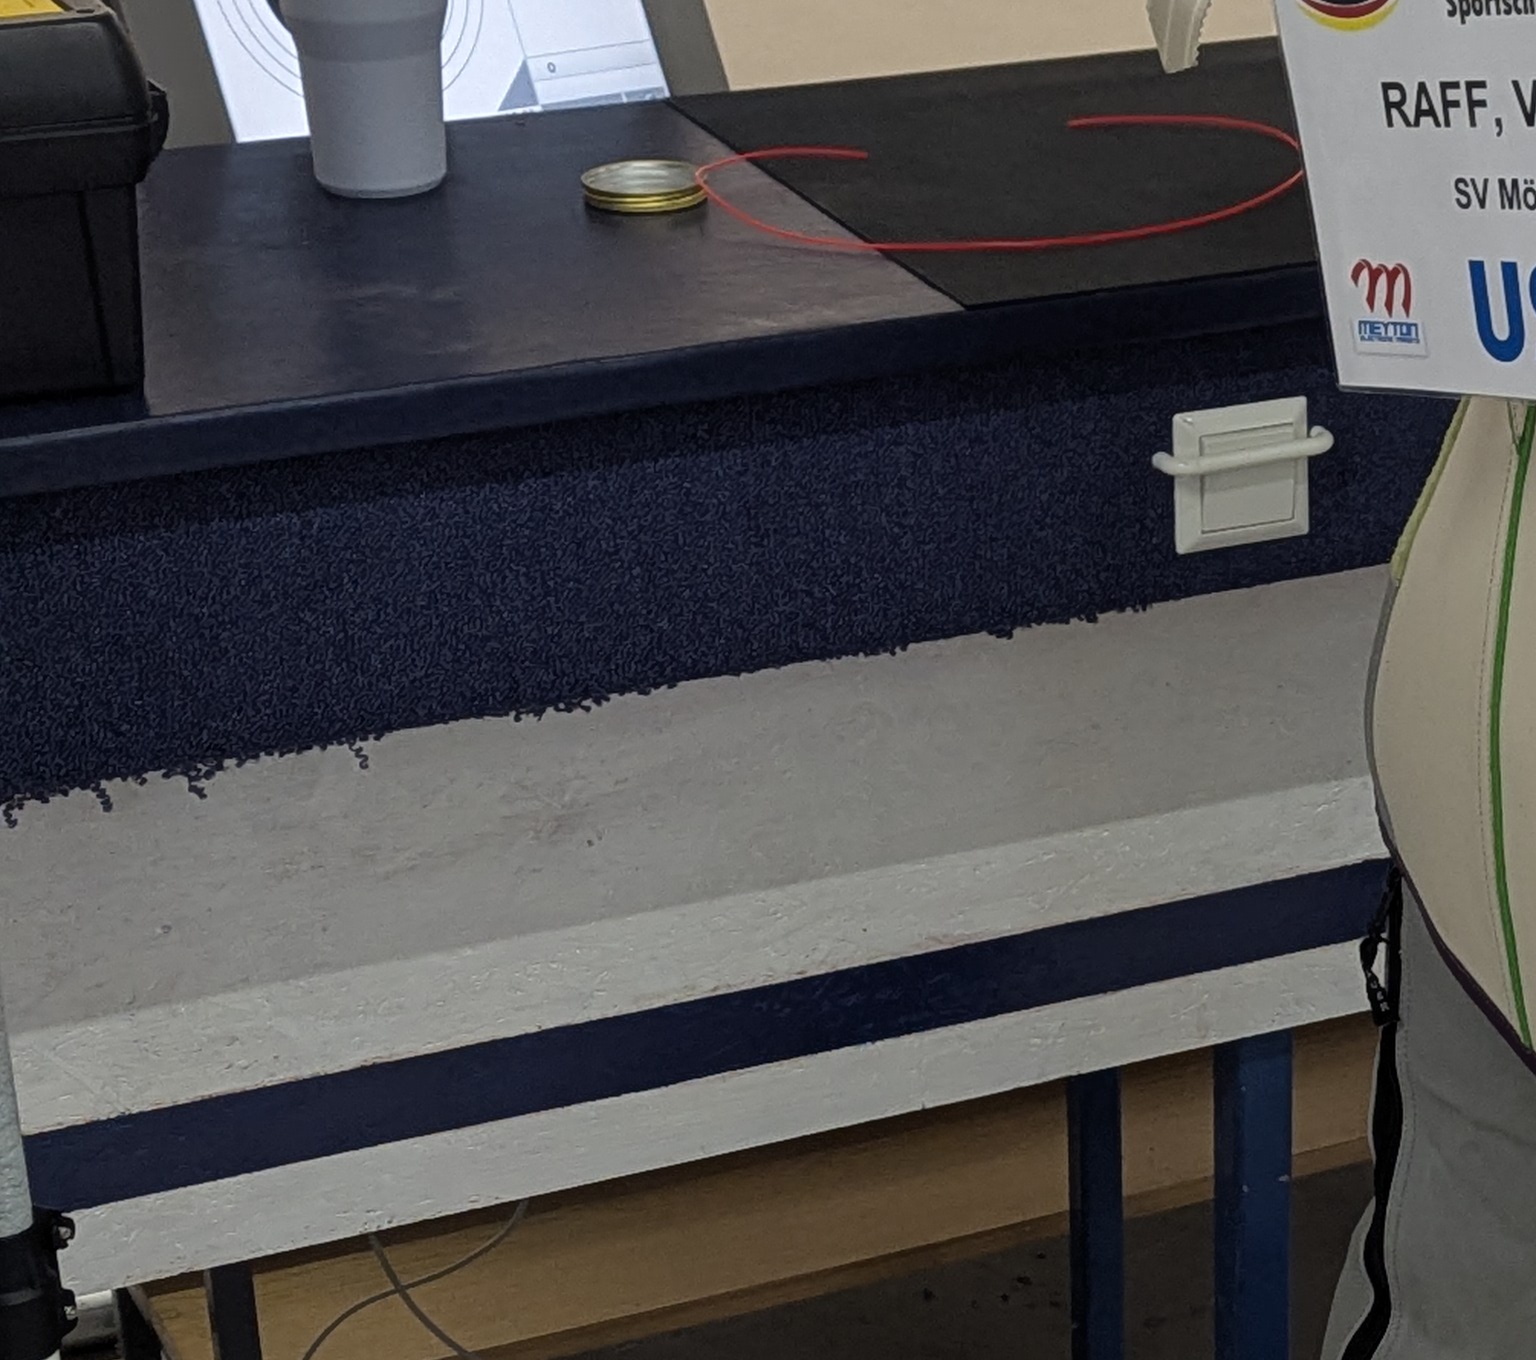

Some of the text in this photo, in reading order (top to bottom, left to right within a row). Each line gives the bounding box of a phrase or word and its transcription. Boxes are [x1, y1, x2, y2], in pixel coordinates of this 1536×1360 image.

[546, 61, 557, 74] 0
[1380, 79, 1504, 138] RAFF,
[1453, 177, 1489, 210] SV
